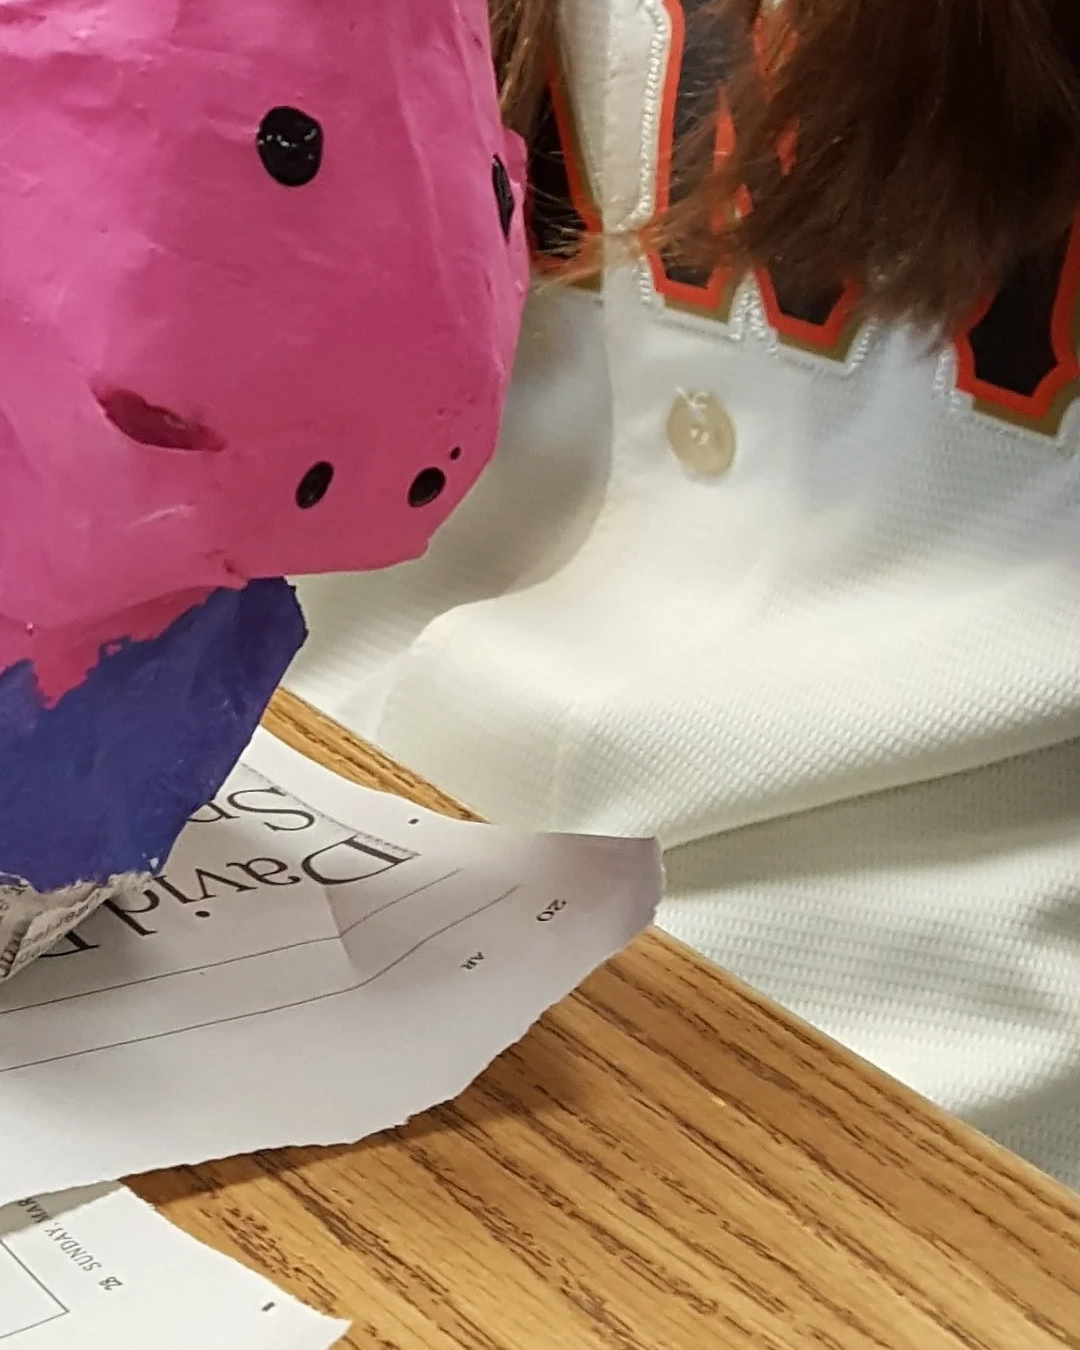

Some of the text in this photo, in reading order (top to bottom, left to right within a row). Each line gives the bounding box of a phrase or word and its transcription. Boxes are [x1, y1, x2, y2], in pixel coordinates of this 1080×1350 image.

[101, 835, 422, 938] David
[459, 951, 486, 971] AR
[45, 1221, 102, 1272] SUNDAY,
[98, 1274, 124, 1291] 28
